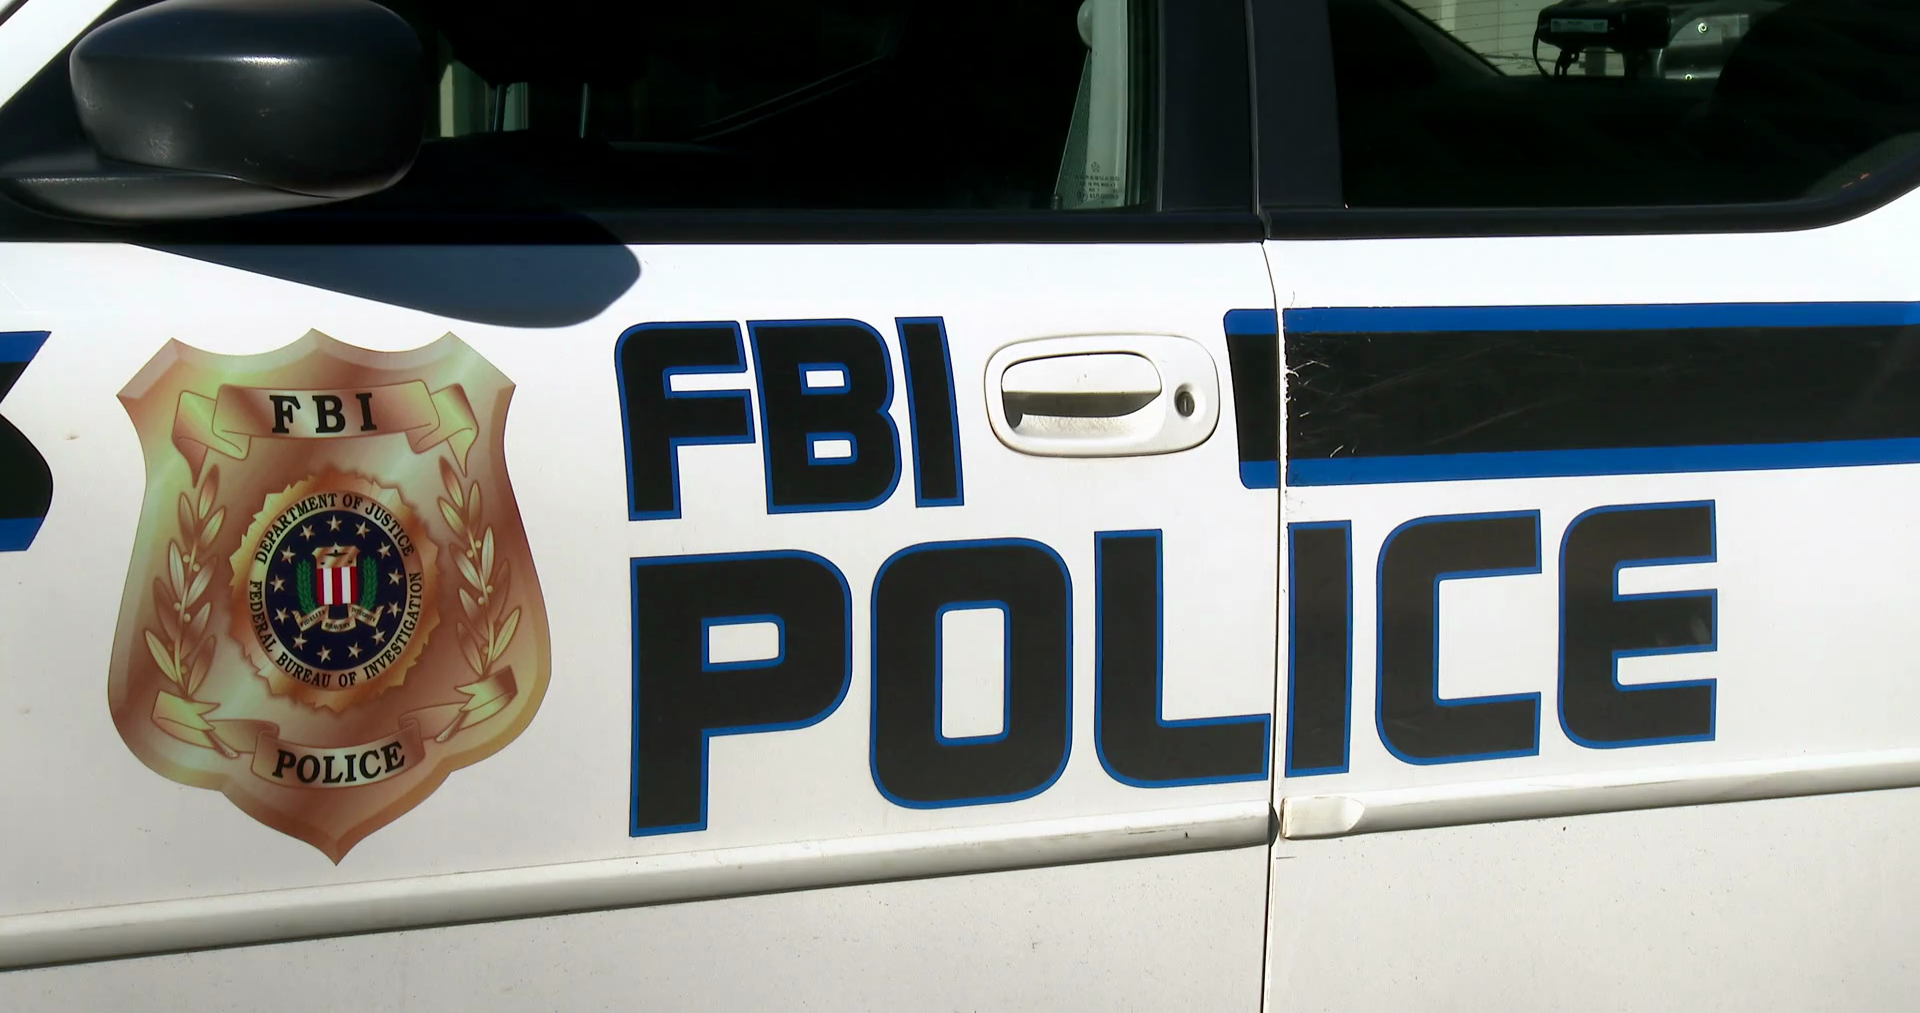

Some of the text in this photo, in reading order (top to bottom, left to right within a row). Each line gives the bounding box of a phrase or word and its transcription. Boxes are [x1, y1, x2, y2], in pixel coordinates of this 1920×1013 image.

[269, 392, 378, 434] FBI
[614, 316, 965, 520] FBI
[254, 493, 415, 565] DEPARTMENT OF JUSTICE
[249, 572, 422, 689] FEDERAL BUREAU OF INVESTIGATION
[629, 499, 1718, 837] POLICE
[272, 741, 405, 784] POLICE
